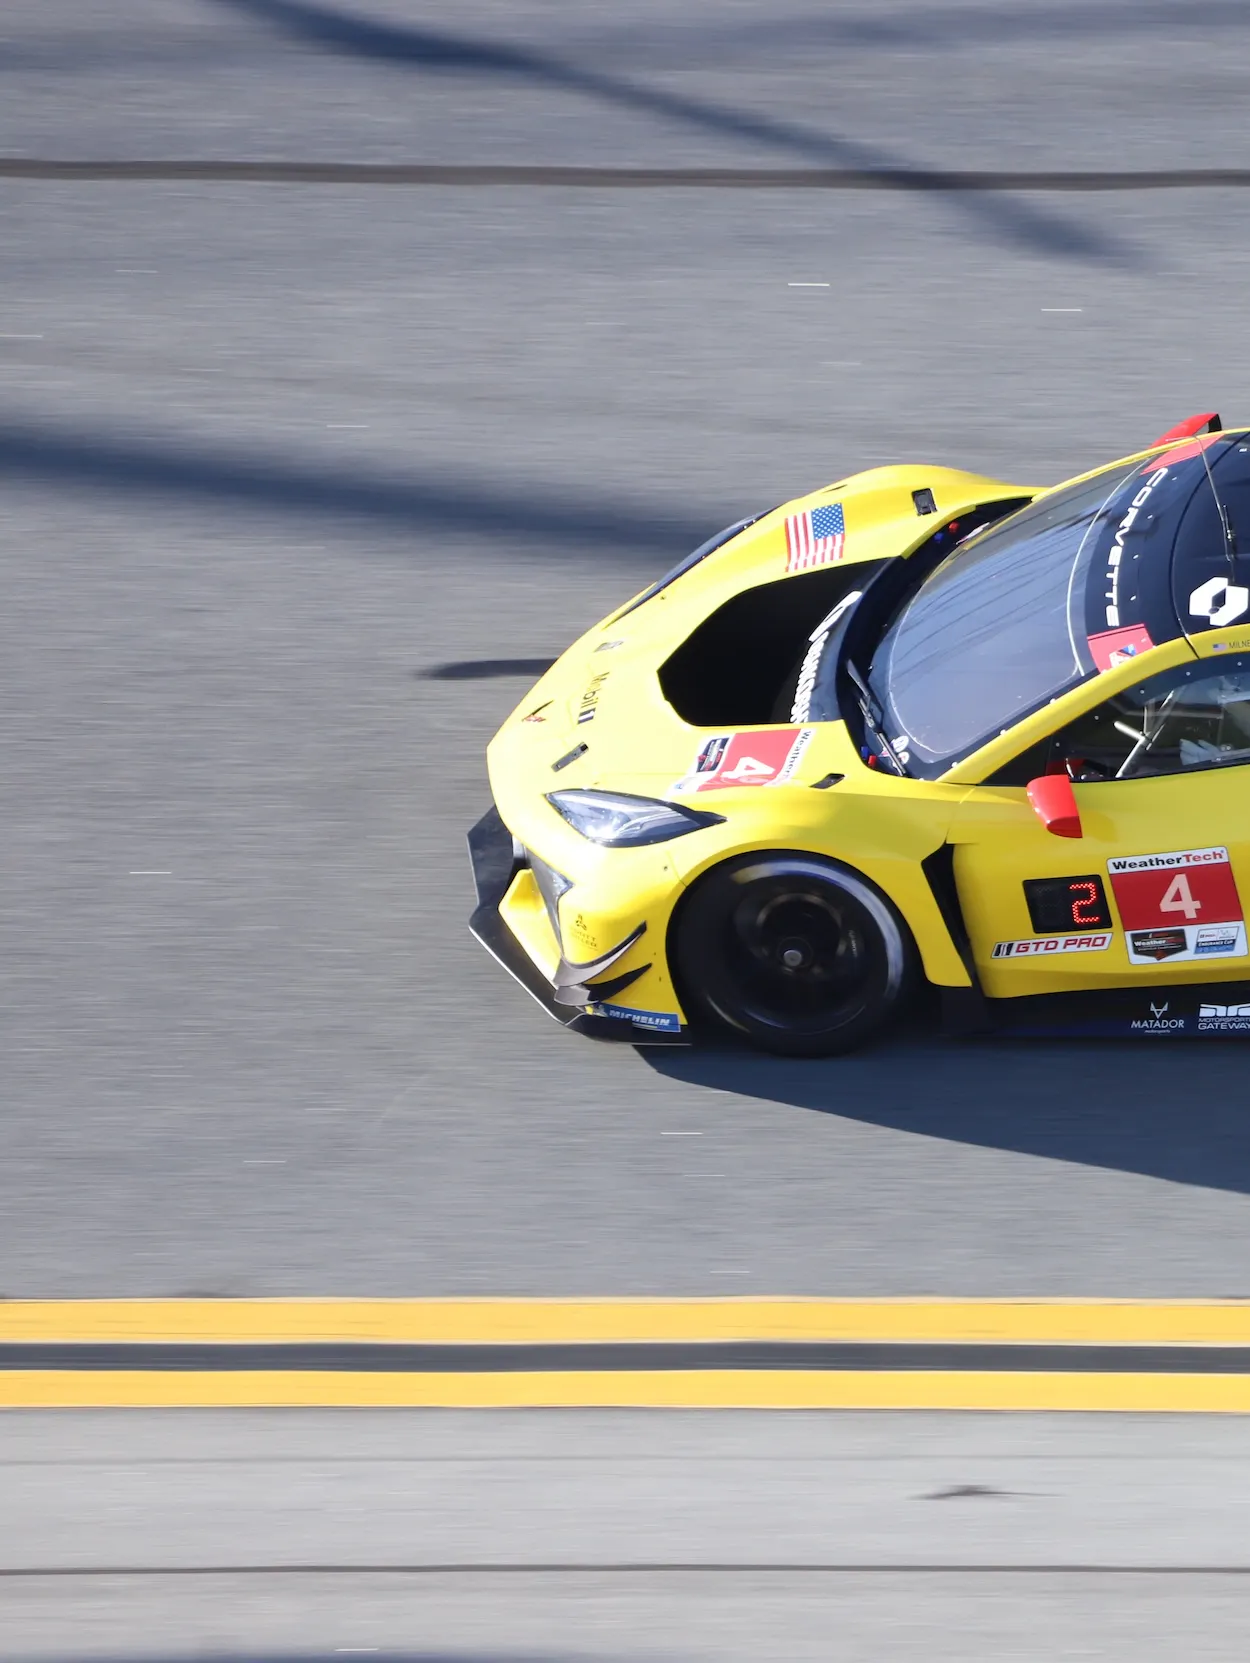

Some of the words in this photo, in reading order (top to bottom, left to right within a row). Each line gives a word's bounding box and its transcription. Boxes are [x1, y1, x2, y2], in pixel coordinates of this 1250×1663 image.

[1105, 467, 1168, 627] CORVETTE
[720, 756, 776, 778] 4
[1112, 850, 1223, 870] WeatherTech
[1070, 882, 1100, 924] 2
[1159, 873, 1202, 919] 4
[1015, 940, 1059, 954] GTD
[1063, 936, 1107, 950] PRO
[609, 1009, 671, 1026] MICHELIN
[1131, 1019, 1185, 1029] MATADOR
